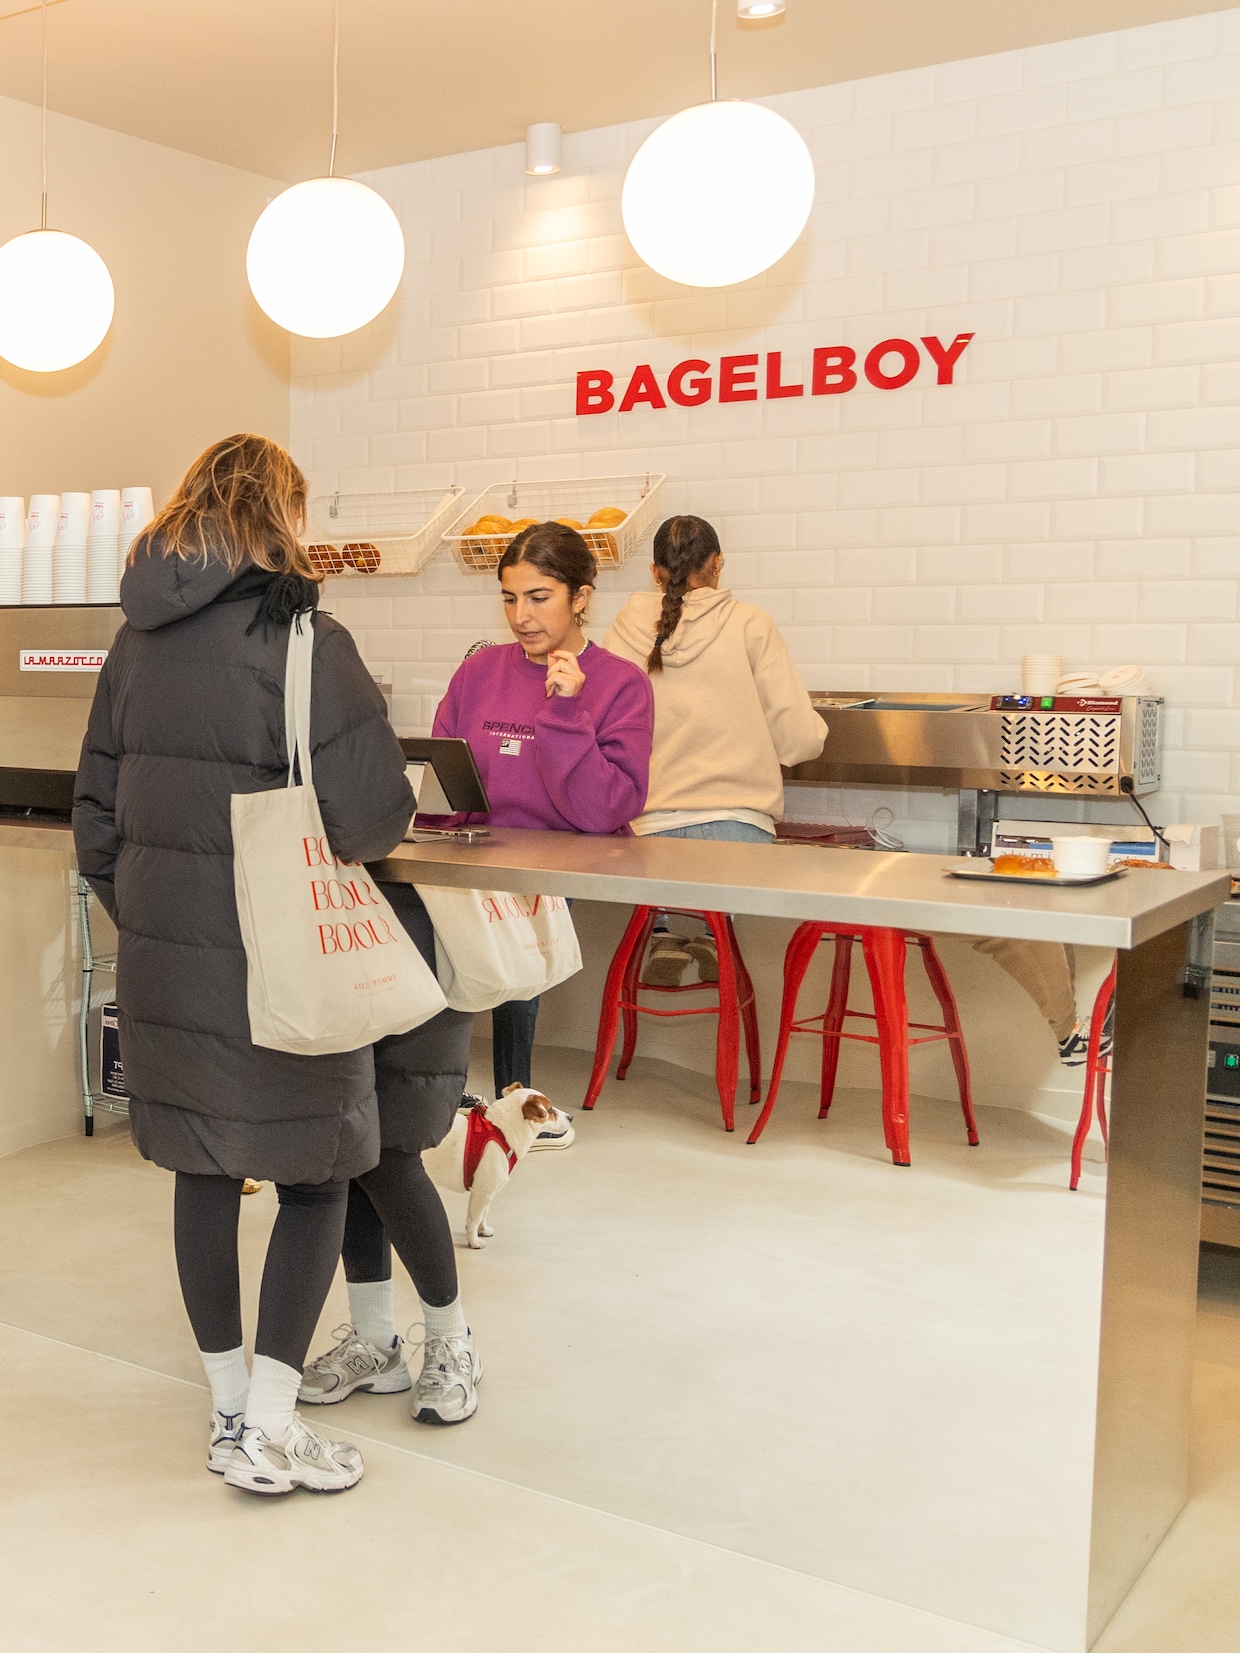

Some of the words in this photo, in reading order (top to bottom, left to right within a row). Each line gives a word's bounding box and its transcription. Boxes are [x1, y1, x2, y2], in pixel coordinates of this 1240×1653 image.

[576, 333, 976, 416] BAGELBOY
[39, 657, 102, 665] MARZOCCO
[304, 1440, 321, 1460] N
